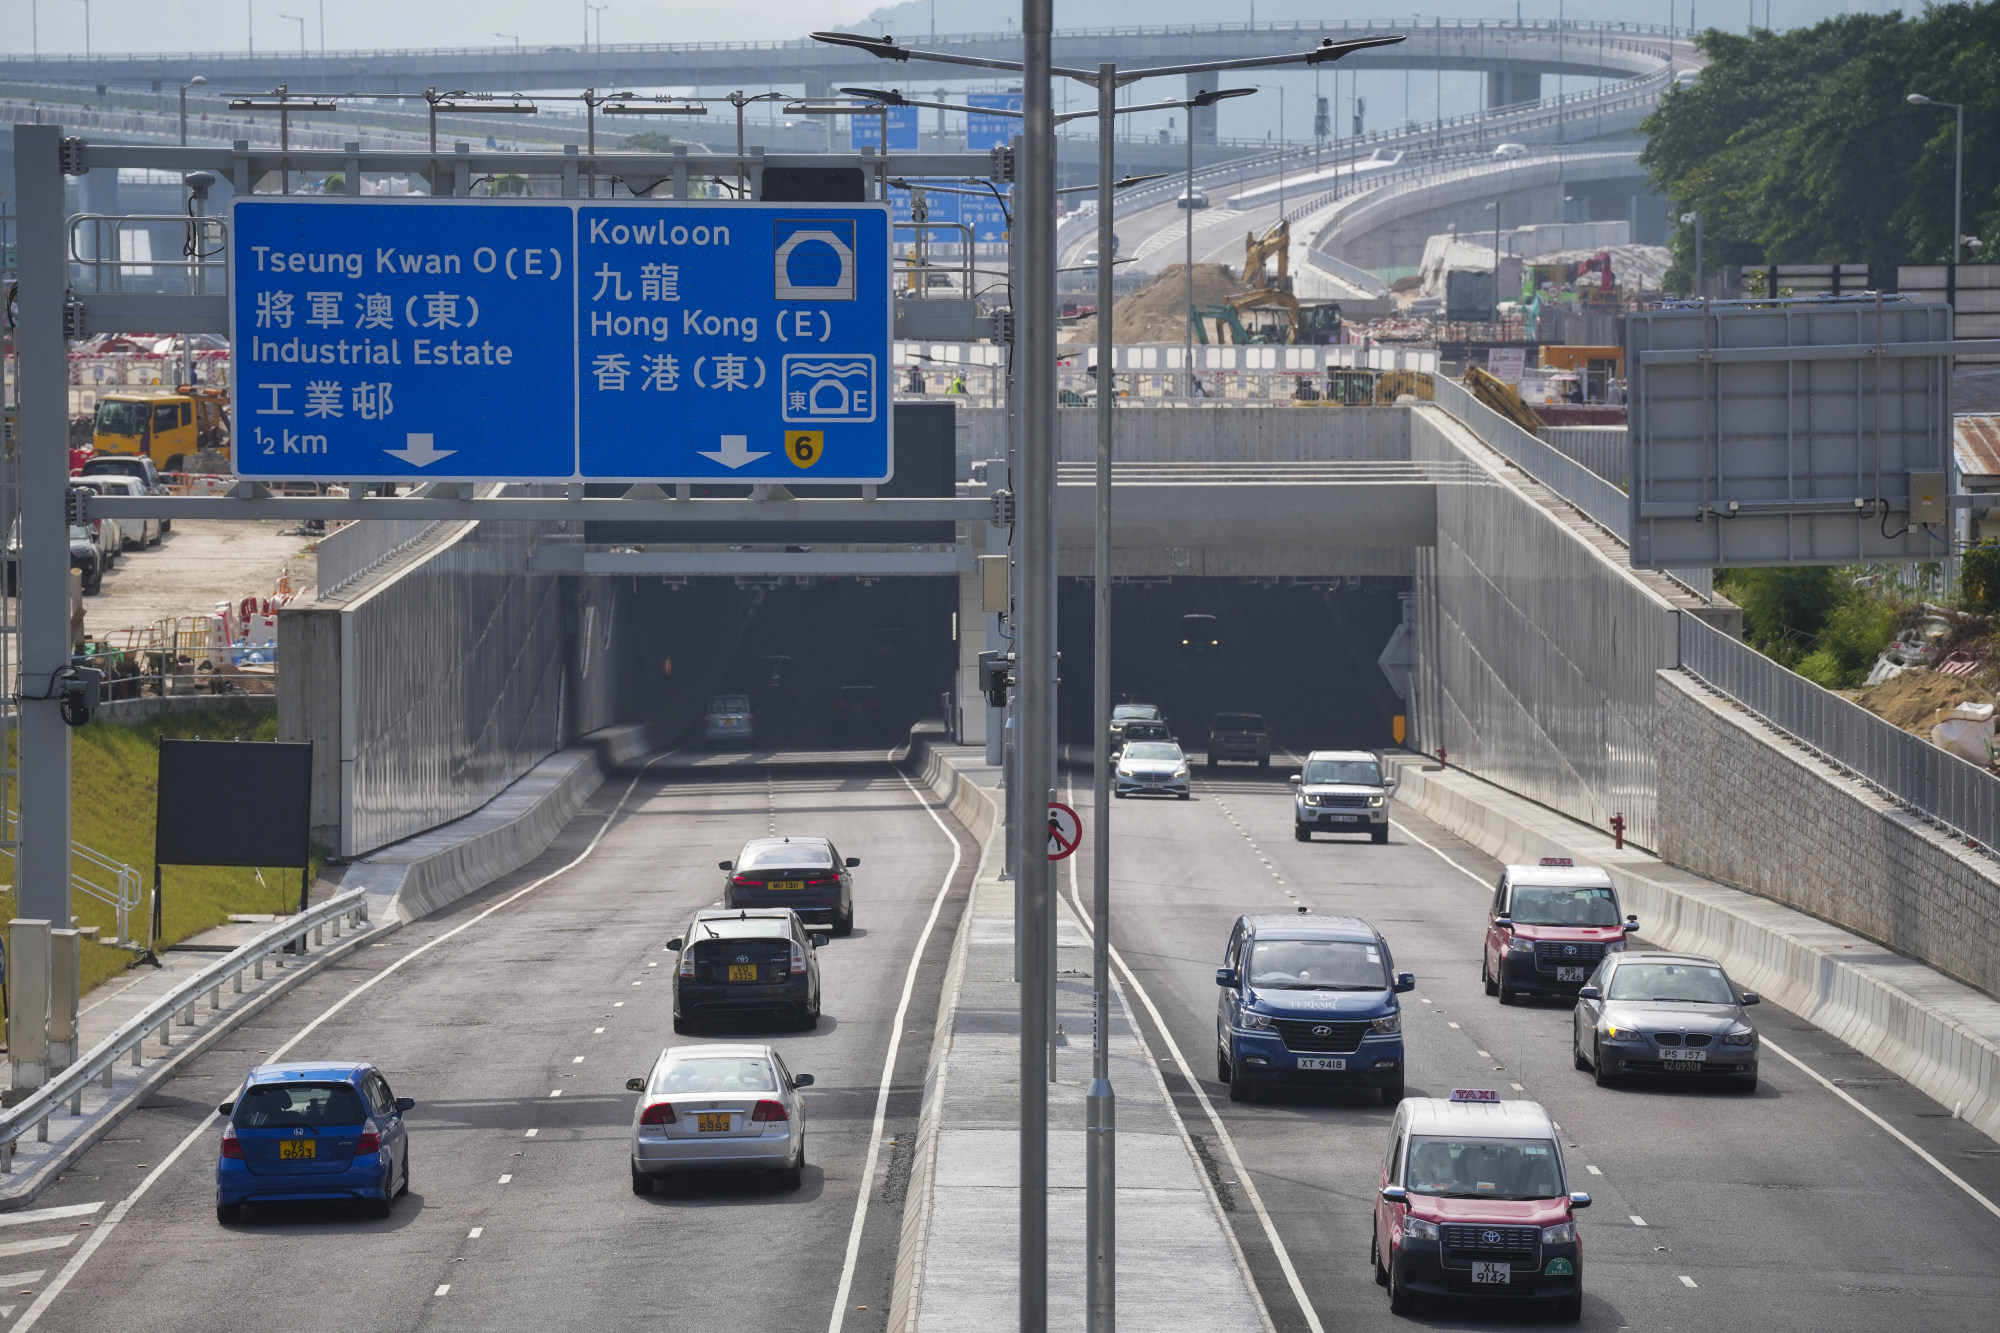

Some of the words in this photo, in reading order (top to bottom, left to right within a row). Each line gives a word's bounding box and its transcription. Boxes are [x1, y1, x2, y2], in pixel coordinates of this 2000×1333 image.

[590, 219, 730, 246] Kowloon
[251, 246, 363, 278] Tseung
[376, 249, 461, 276] Kwan
[592, 262, 681, 302] 九龍
[256, 290, 479, 330] 將軍澳(東)
[591, 310, 668, 342] Hong
[683, 310, 758, 342] Kong
[776, 310, 832, 342] (E)
[253, 335, 402, 366] Industrial
[414, 339, 513, 366] Estate
[592, 352, 766, 392] 香港(東)
[256, 380, 394, 420] 工業邨
[788, 391, 808, 412] 東
[853, 390, 868, 411] E
[283, 429, 328, 454] km
[795, 436, 813, 461] 6
[732, 972, 753, 980] 3315
[1290, 1001, 1338, 1010] FERRARI
[1665, 1050, 1678, 1058] PS
[1685, 1051, 1701, 1059] 157
[1301, 1059, 1315, 1068] XT
[1319, 1060, 1342, 1069] 9418
[1456, 1090, 1495, 1099] TAXI
[706, 1114, 722, 1122] LY
[699, 1122, 730, 1132] 5993
[291, 1139, 304, 1149] VX
[283, 1149, 312, 1159] 9623
[1483, 1263, 1499, 1273] XL
[1477, 1272, 1506, 1283] 9142
